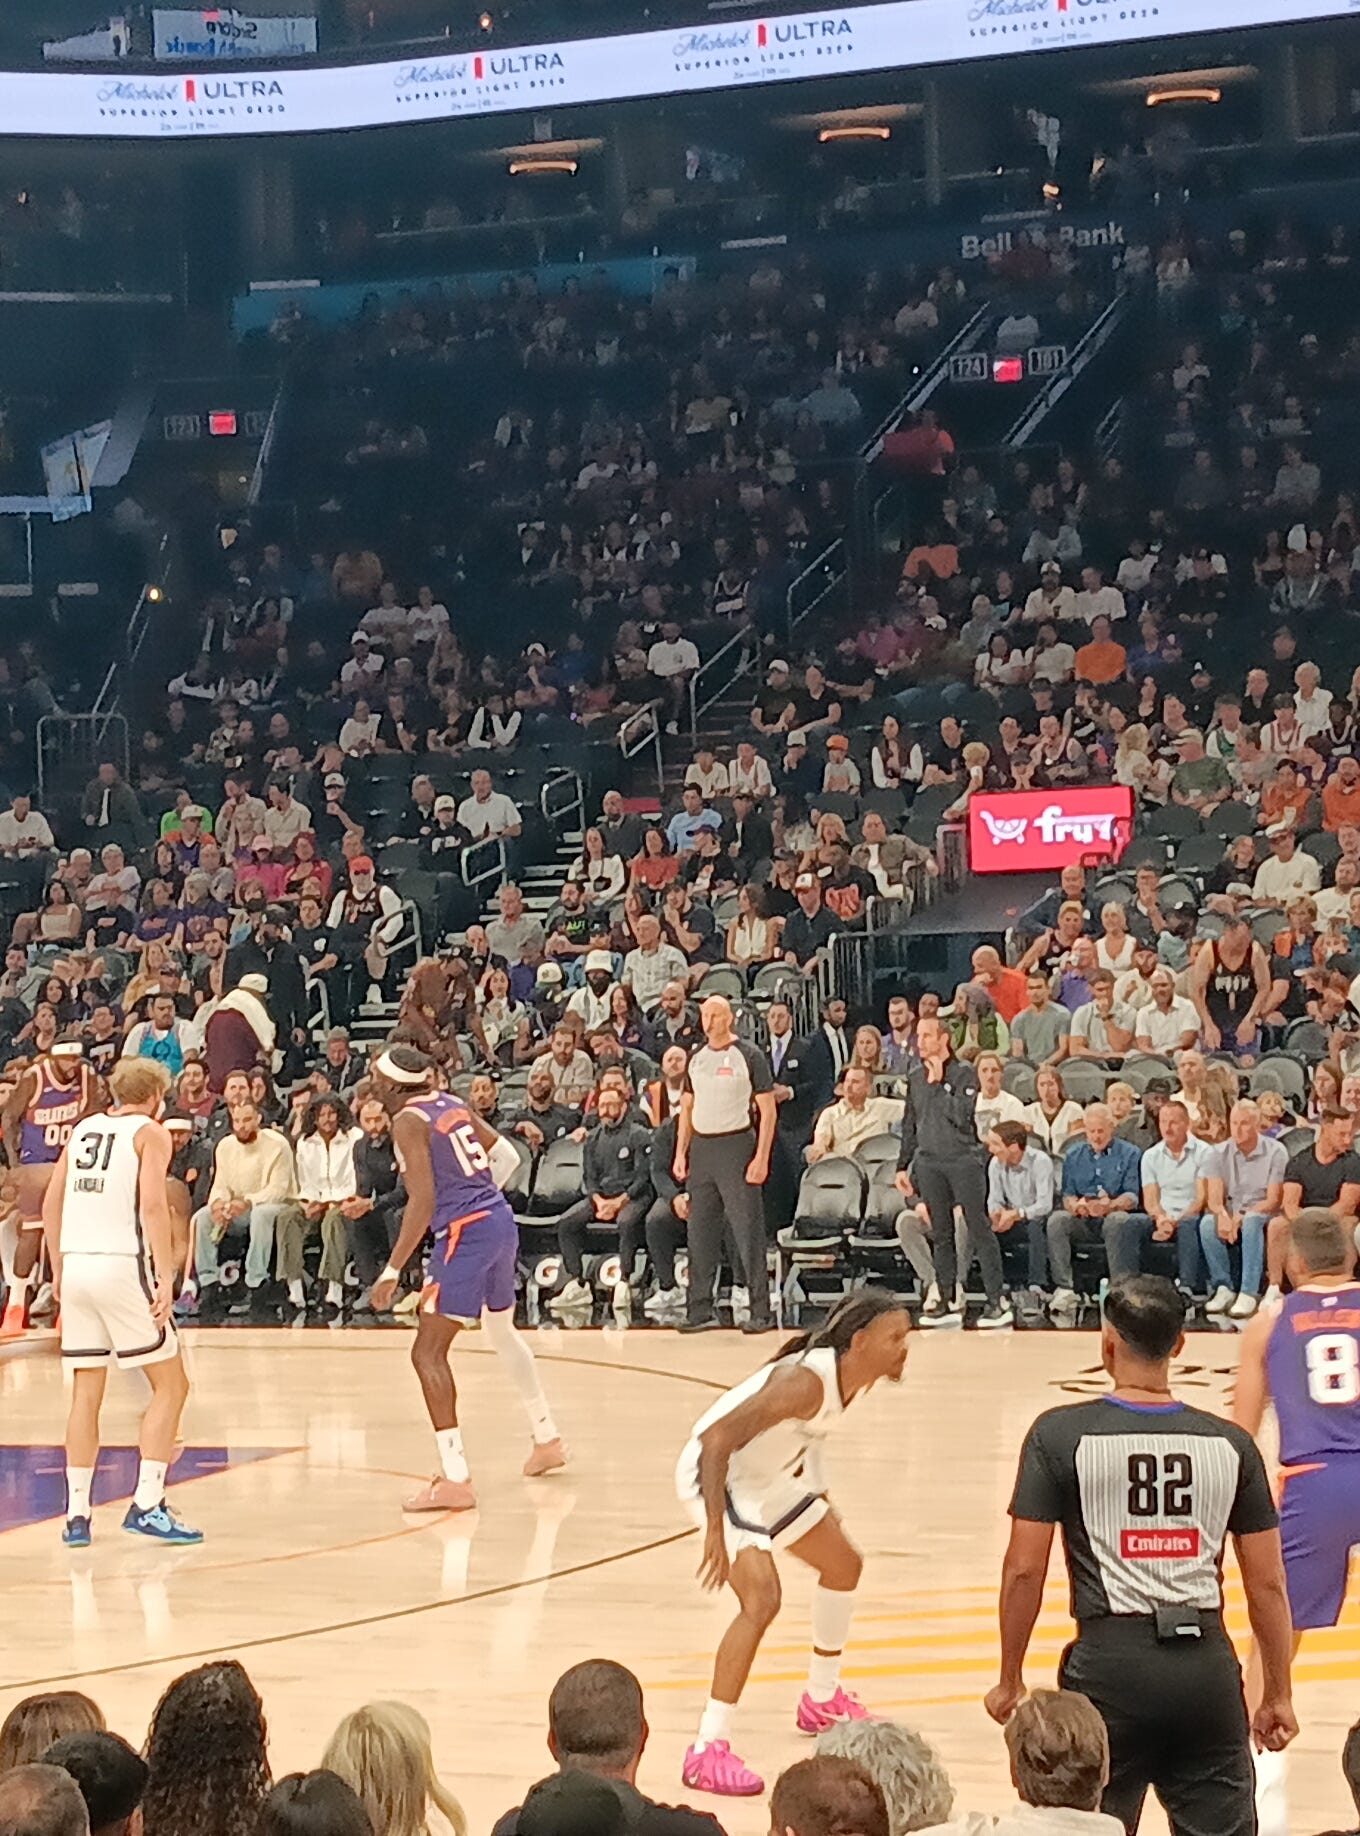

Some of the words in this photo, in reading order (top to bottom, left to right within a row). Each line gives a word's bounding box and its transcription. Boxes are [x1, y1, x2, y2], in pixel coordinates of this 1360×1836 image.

[774, 18, 853, 43] ULTRA
[490, 52, 565, 75] ULTRA
[203, 80, 284, 99] ULTRA
[961, 231, 1013, 259] Bell
[1058, 221, 1124, 247] Bank
[75, 1131, 117, 1172] 31
[448, 1123, 489, 1178] 15
[1127, 1453, 1193, 1517] 82
[1127, 1532, 1193, 1553] Emirates
